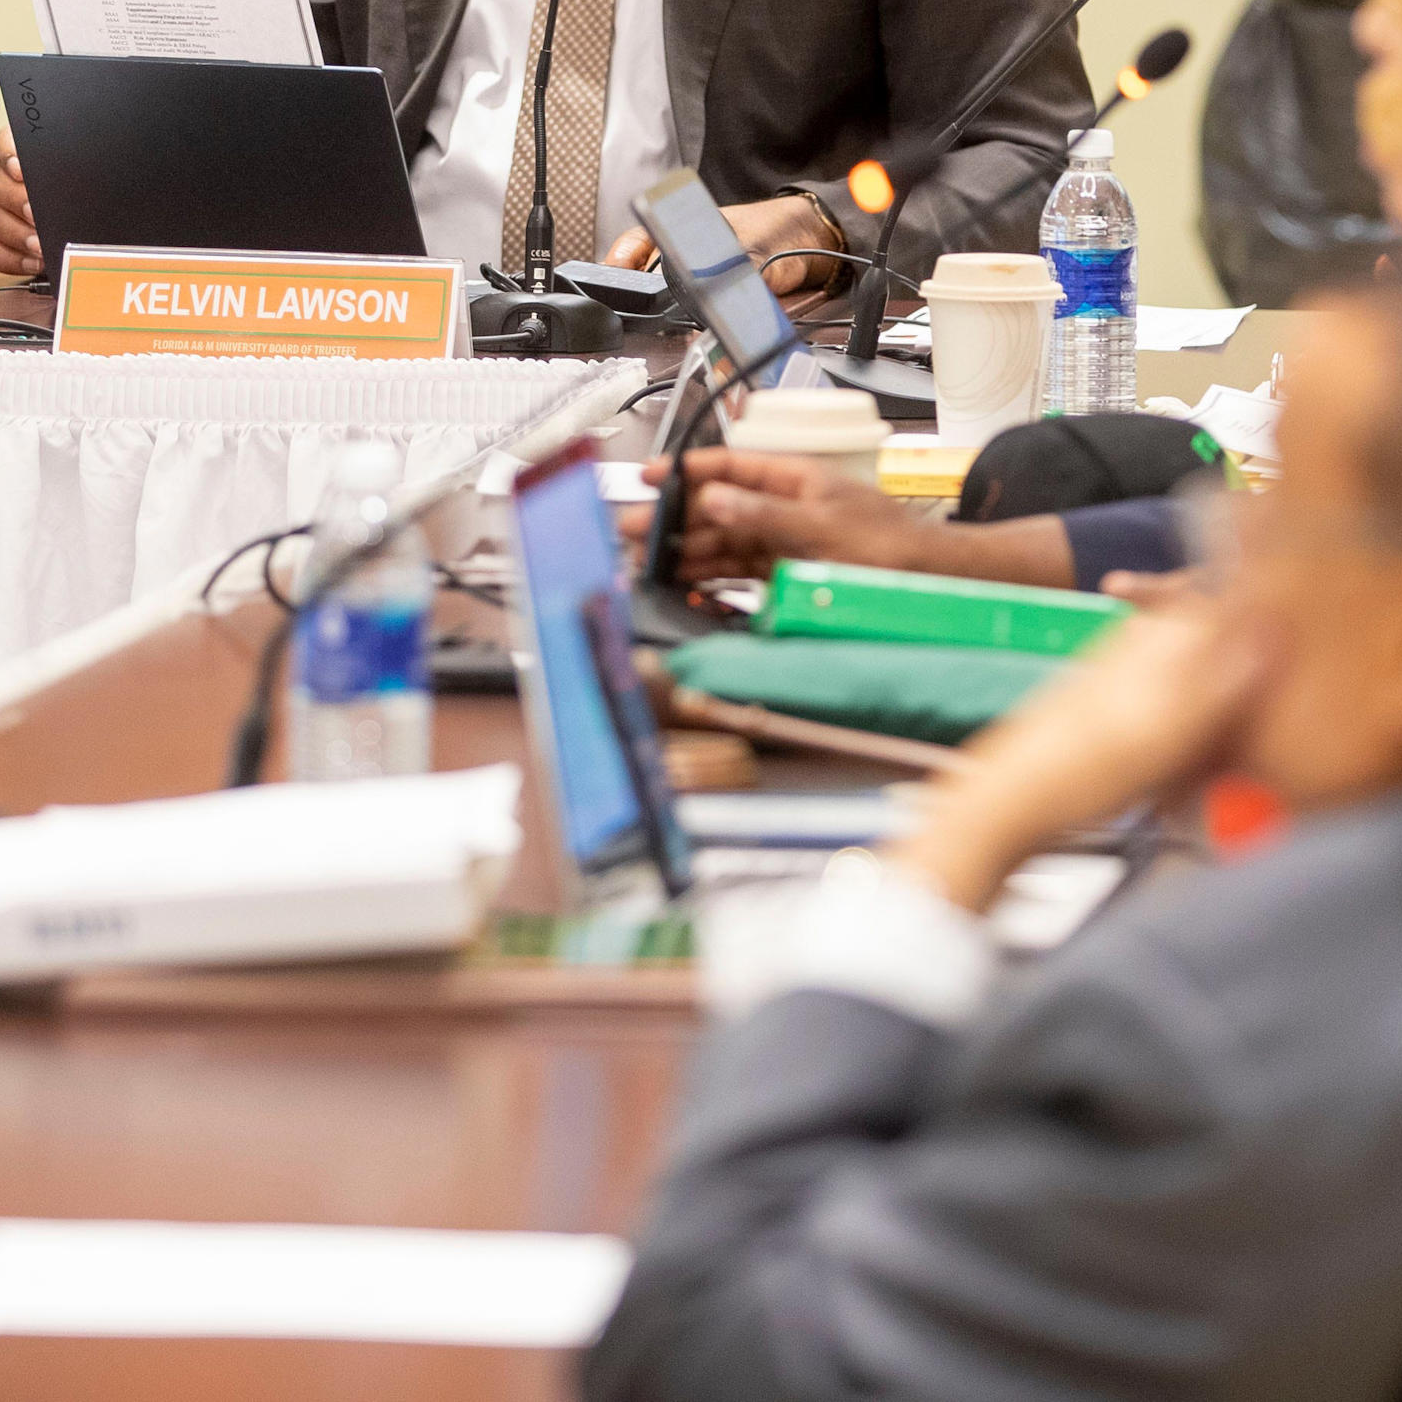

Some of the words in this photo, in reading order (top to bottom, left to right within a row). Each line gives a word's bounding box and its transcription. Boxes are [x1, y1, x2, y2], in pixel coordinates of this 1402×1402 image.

[18, 78, 46, 133] YOGA
[122, 281, 248, 318] KELVIN
[256, 287, 409, 323] LAWSON
[152, 339, 189, 350] FLORIDA
[216, 341, 267, 353] UNIVERSITY
[269, 343, 299, 355] BOARD
[301, 344, 313, 355] OF
[314, 344, 357, 356] TRUSTEES
